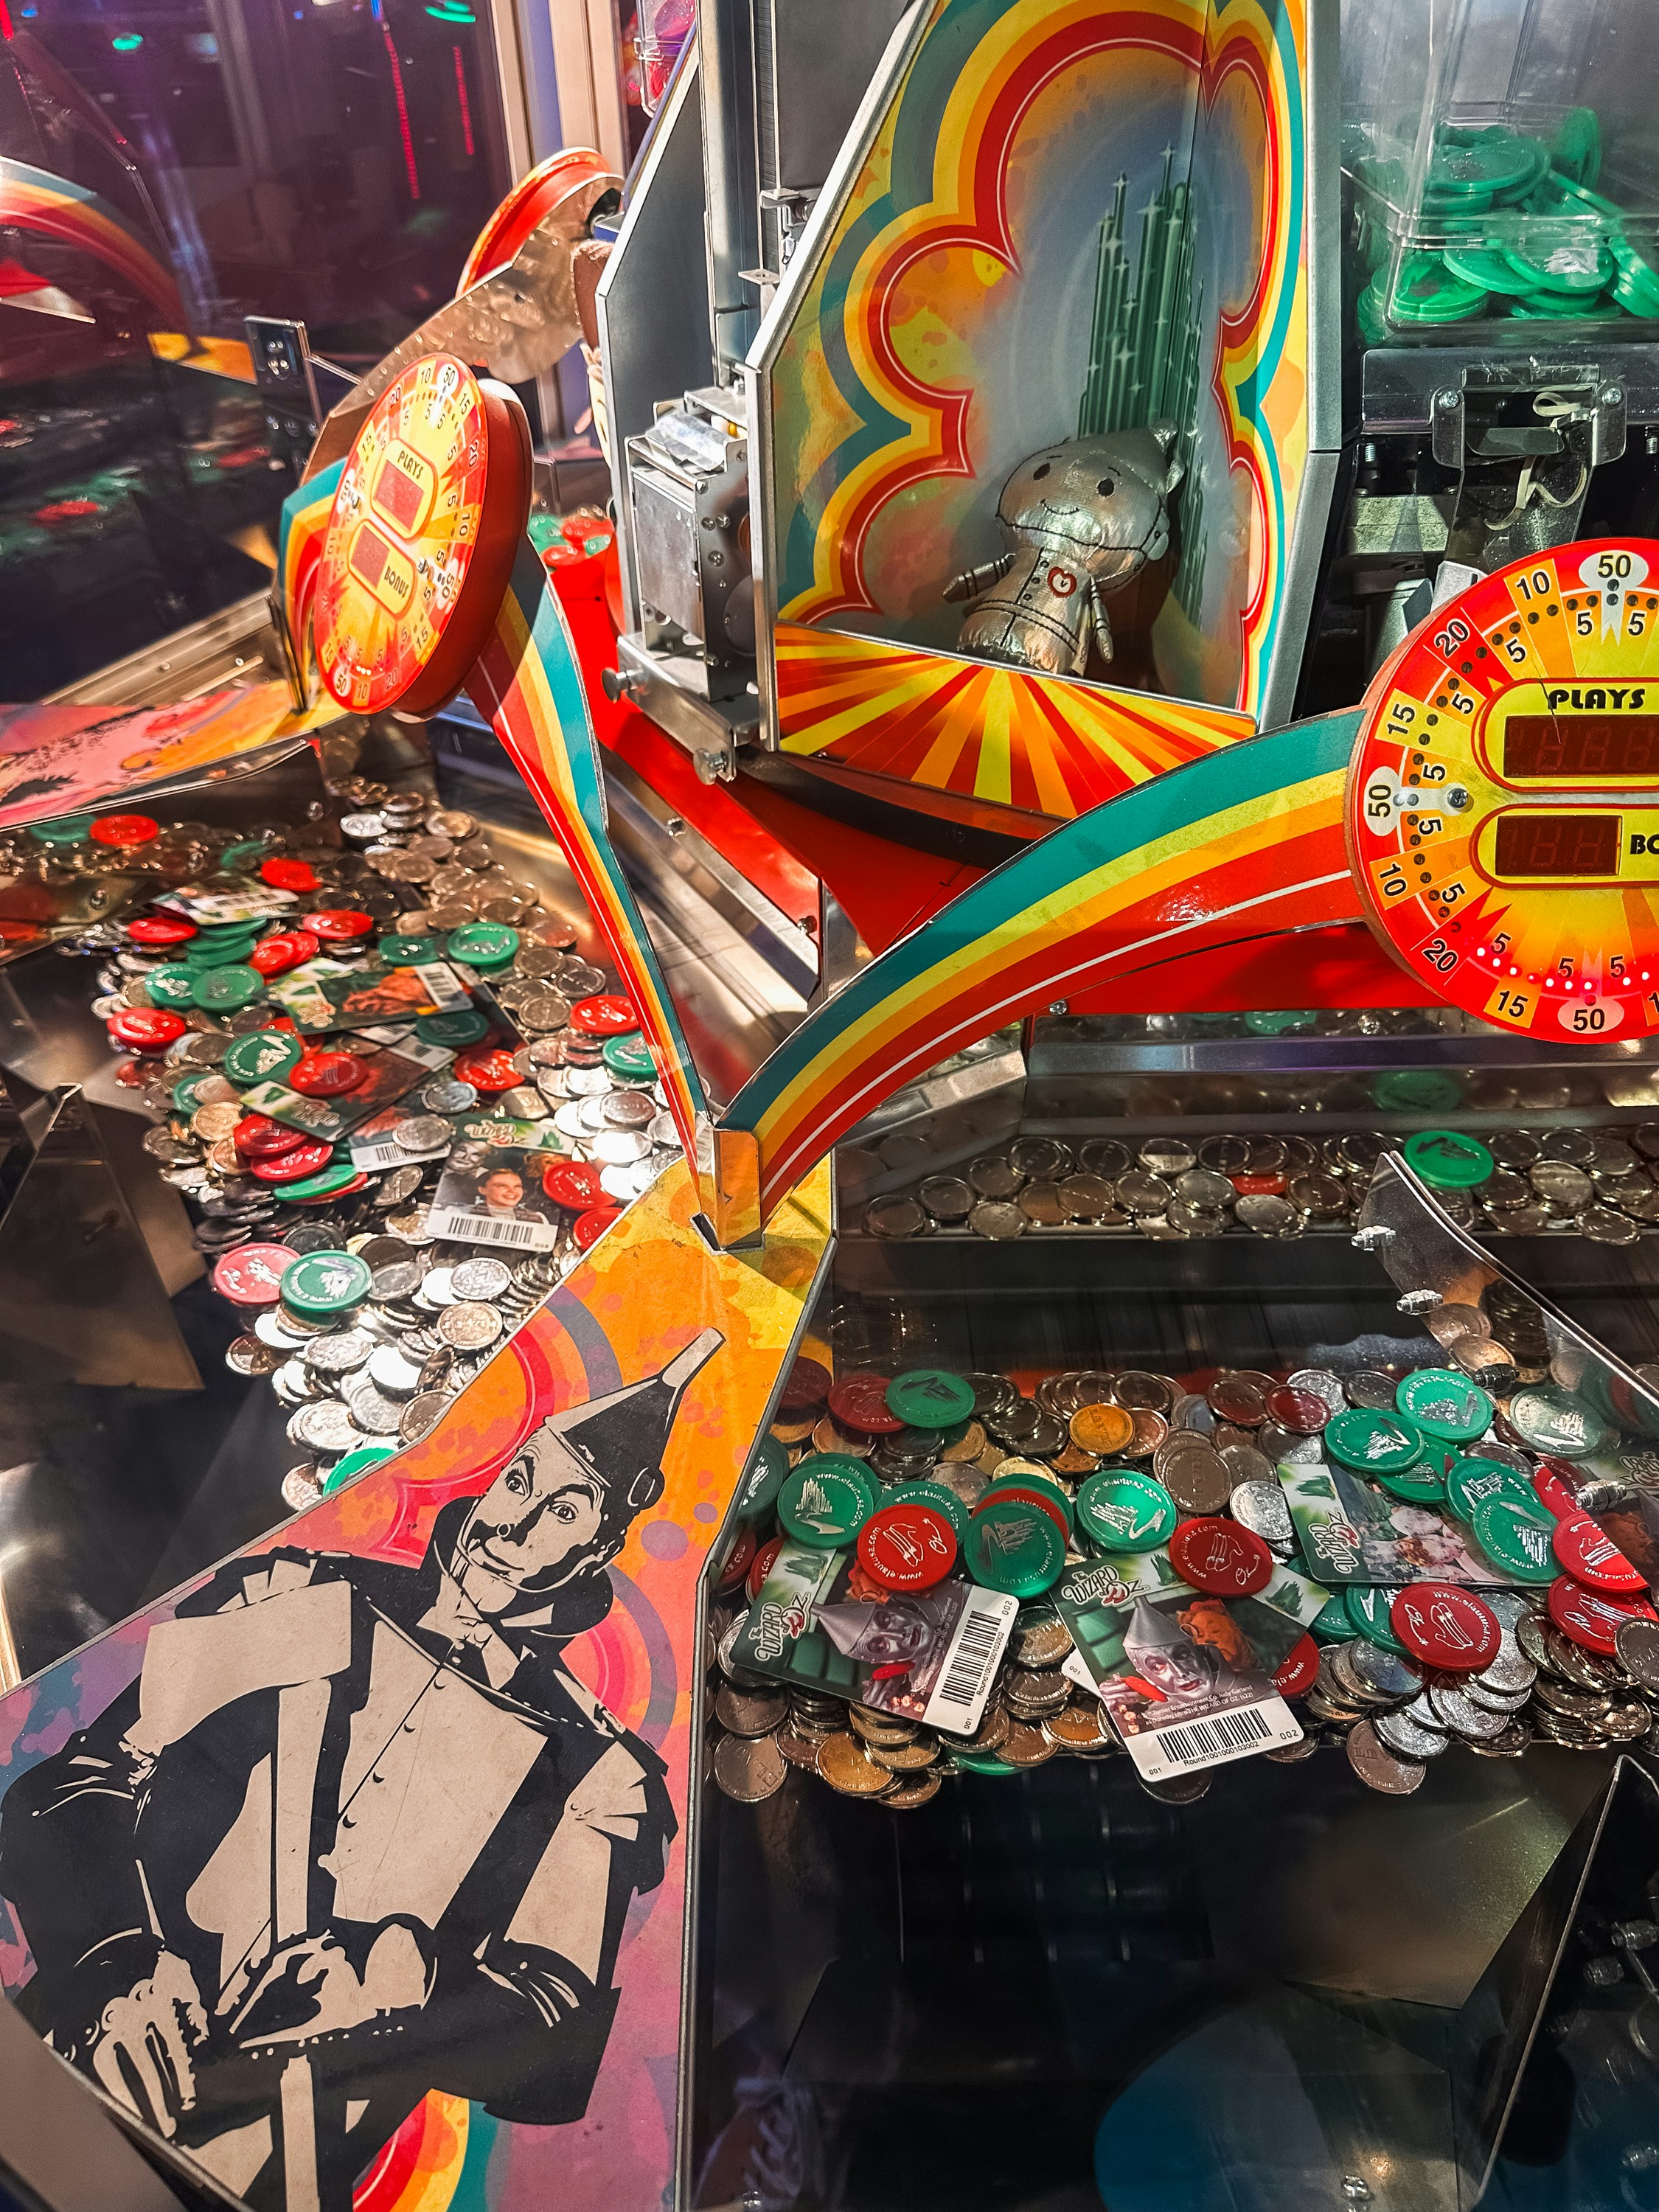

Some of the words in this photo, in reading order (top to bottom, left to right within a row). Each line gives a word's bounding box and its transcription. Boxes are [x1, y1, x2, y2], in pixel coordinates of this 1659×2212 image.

[421, 368, 431, 384] 10
[444, 367, 455, 386] 50
[390, 387, 401, 408] 20
[459, 393, 470, 414] 15
[403, 408, 409, 425] 5
[425, 403, 432, 420] 5
[437, 414, 445, 429] 5
[448, 442, 456, 461] 5
[469, 442, 478, 467] 20
[397, 451, 423, 479] PLAYS
[448, 495, 456, 507] 5
[459, 512, 470, 536] 10
[437, 549, 445, 562] 5
[1598, 554, 1631, 578] 50
[384, 566, 409, 598] BONUS
[442, 573, 454, 599] 50
[1517, 571, 1549, 600] 10
[423, 587, 431, 601] 5
[1577, 612, 1593, 636] 5
[1628, 613, 1645, 636] 5
[417, 626, 428, 649] 15
[1435, 621, 1469, 657] 20
[1506, 639, 1526, 663] 5
[336, 674, 347, 694] 50
[358, 684, 367, 699] 10
[1452, 694, 1474, 714] 5
[1548, 689, 1645, 709] PLAYS
[1387, 703, 1415, 735] 15
[1423, 765, 1445, 781] 5
[1368, 785, 1391, 818] 50
[1419, 819, 1441, 835] 5
[1380, 863, 1407, 897] 10
[1442, 883, 1466, 903] 5
[1491, 933, 1511, 954] 5
[1423, 940, 1458, 972] 20
[1557, 958, 1574, 978] 5
[1610, 956, 1625, 978] 5
[1498, 991, 1528, 1017] 15
[1573, 1009, 1605, 1031] 50
[1063, 1566, 1118, 1603] WIZARD
[1001, 1600, 1012, 1615] 002
[757, 1603, 782, 1659] WIZARD
[1069, 1666, 1081, 1674] 001
[1231, 1685, 1253, 1694] Garland
[964, 1717, 973, 1729] 001
[1152, 1714, 1175, 1723] Dorothy
[1279, 1729, 1299, 1740] 002
[1183, 1741, 1259, 1767] Round1001000103002
[1149, 1767, 1162, 1775] 001
